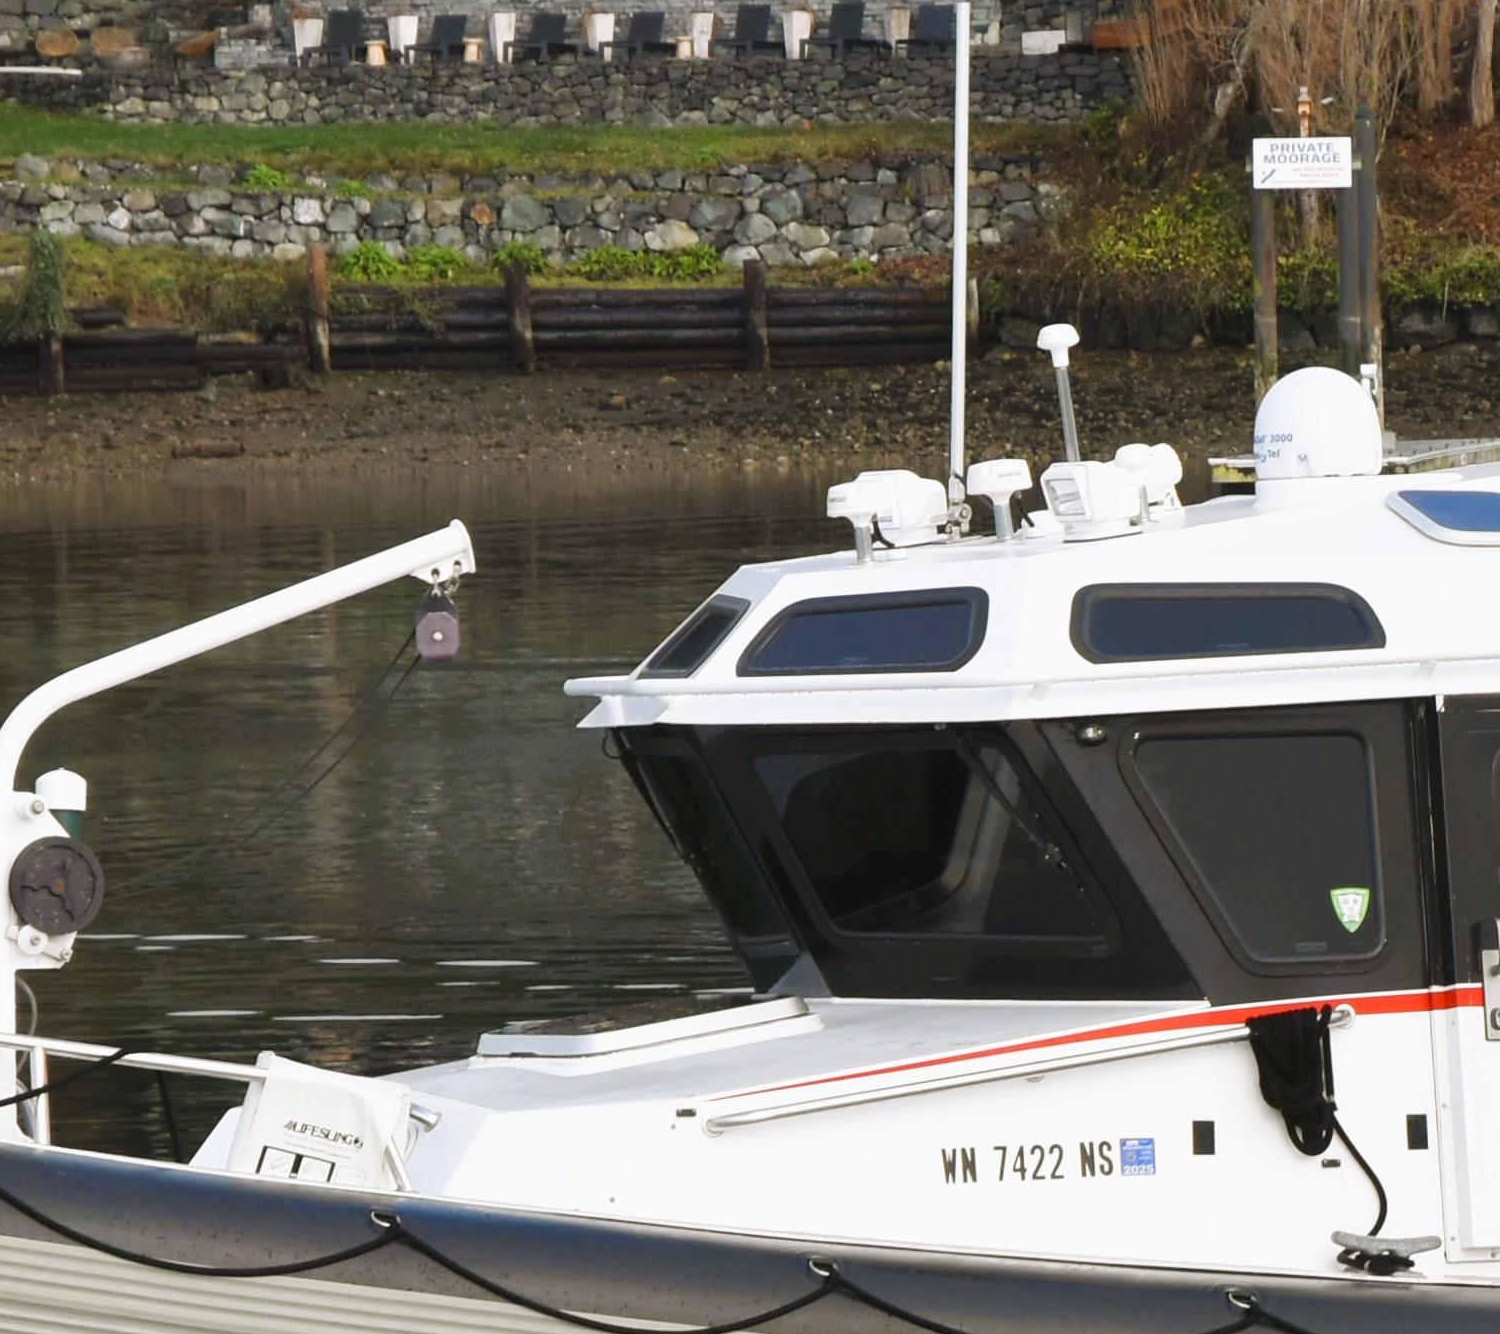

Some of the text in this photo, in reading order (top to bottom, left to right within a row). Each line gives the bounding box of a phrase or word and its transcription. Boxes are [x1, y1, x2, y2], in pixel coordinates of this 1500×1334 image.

[1270, 142, 1334, 153] PRIVATE
[1263, 153, 1341, 164] MOORAGE
[941, 1147, 978, 1184] WN
[993, 1143, 1065, 1182] 7422
[1079, 1140, 1114, 1178] NS
